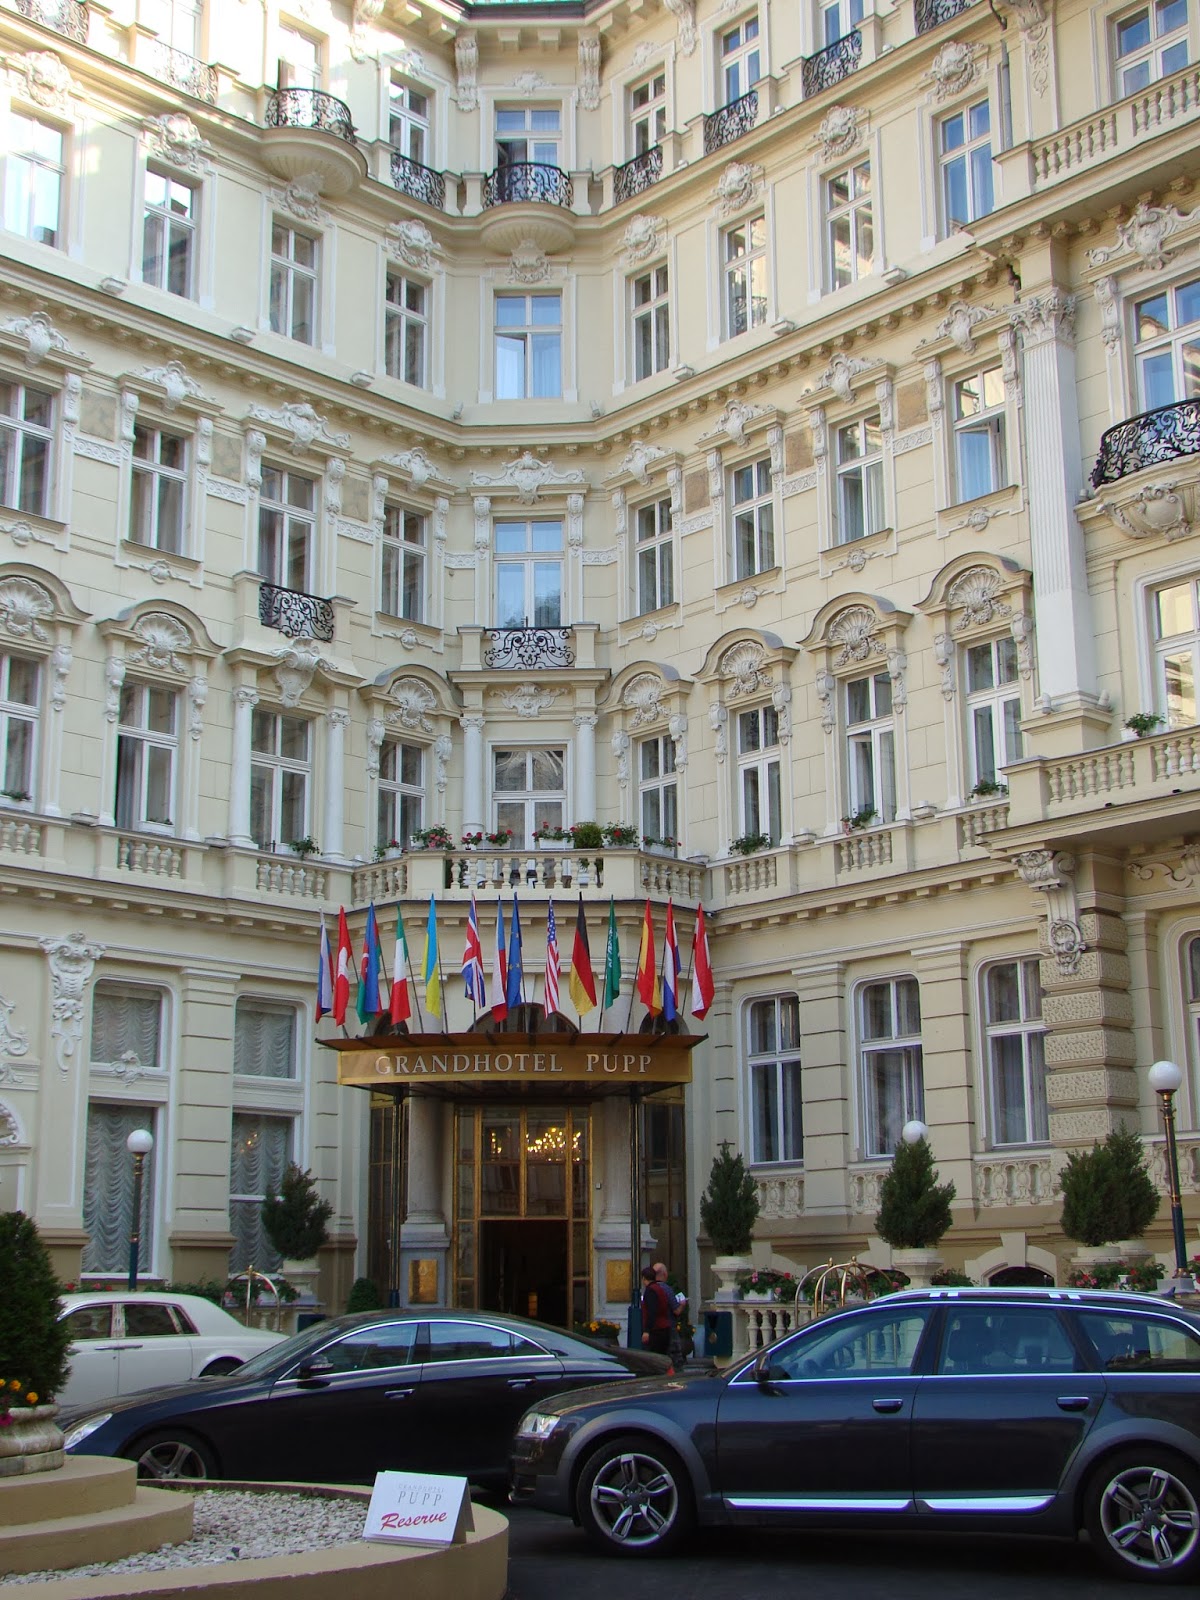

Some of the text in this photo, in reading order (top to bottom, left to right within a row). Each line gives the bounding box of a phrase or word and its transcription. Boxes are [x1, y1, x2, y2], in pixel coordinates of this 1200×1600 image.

[375, 1053, 652, 1074] GRANDHOTEL PUPP
[398, 1491, 442, 1506] PUPP
[380, 1512, 447, 1531] Reserve
